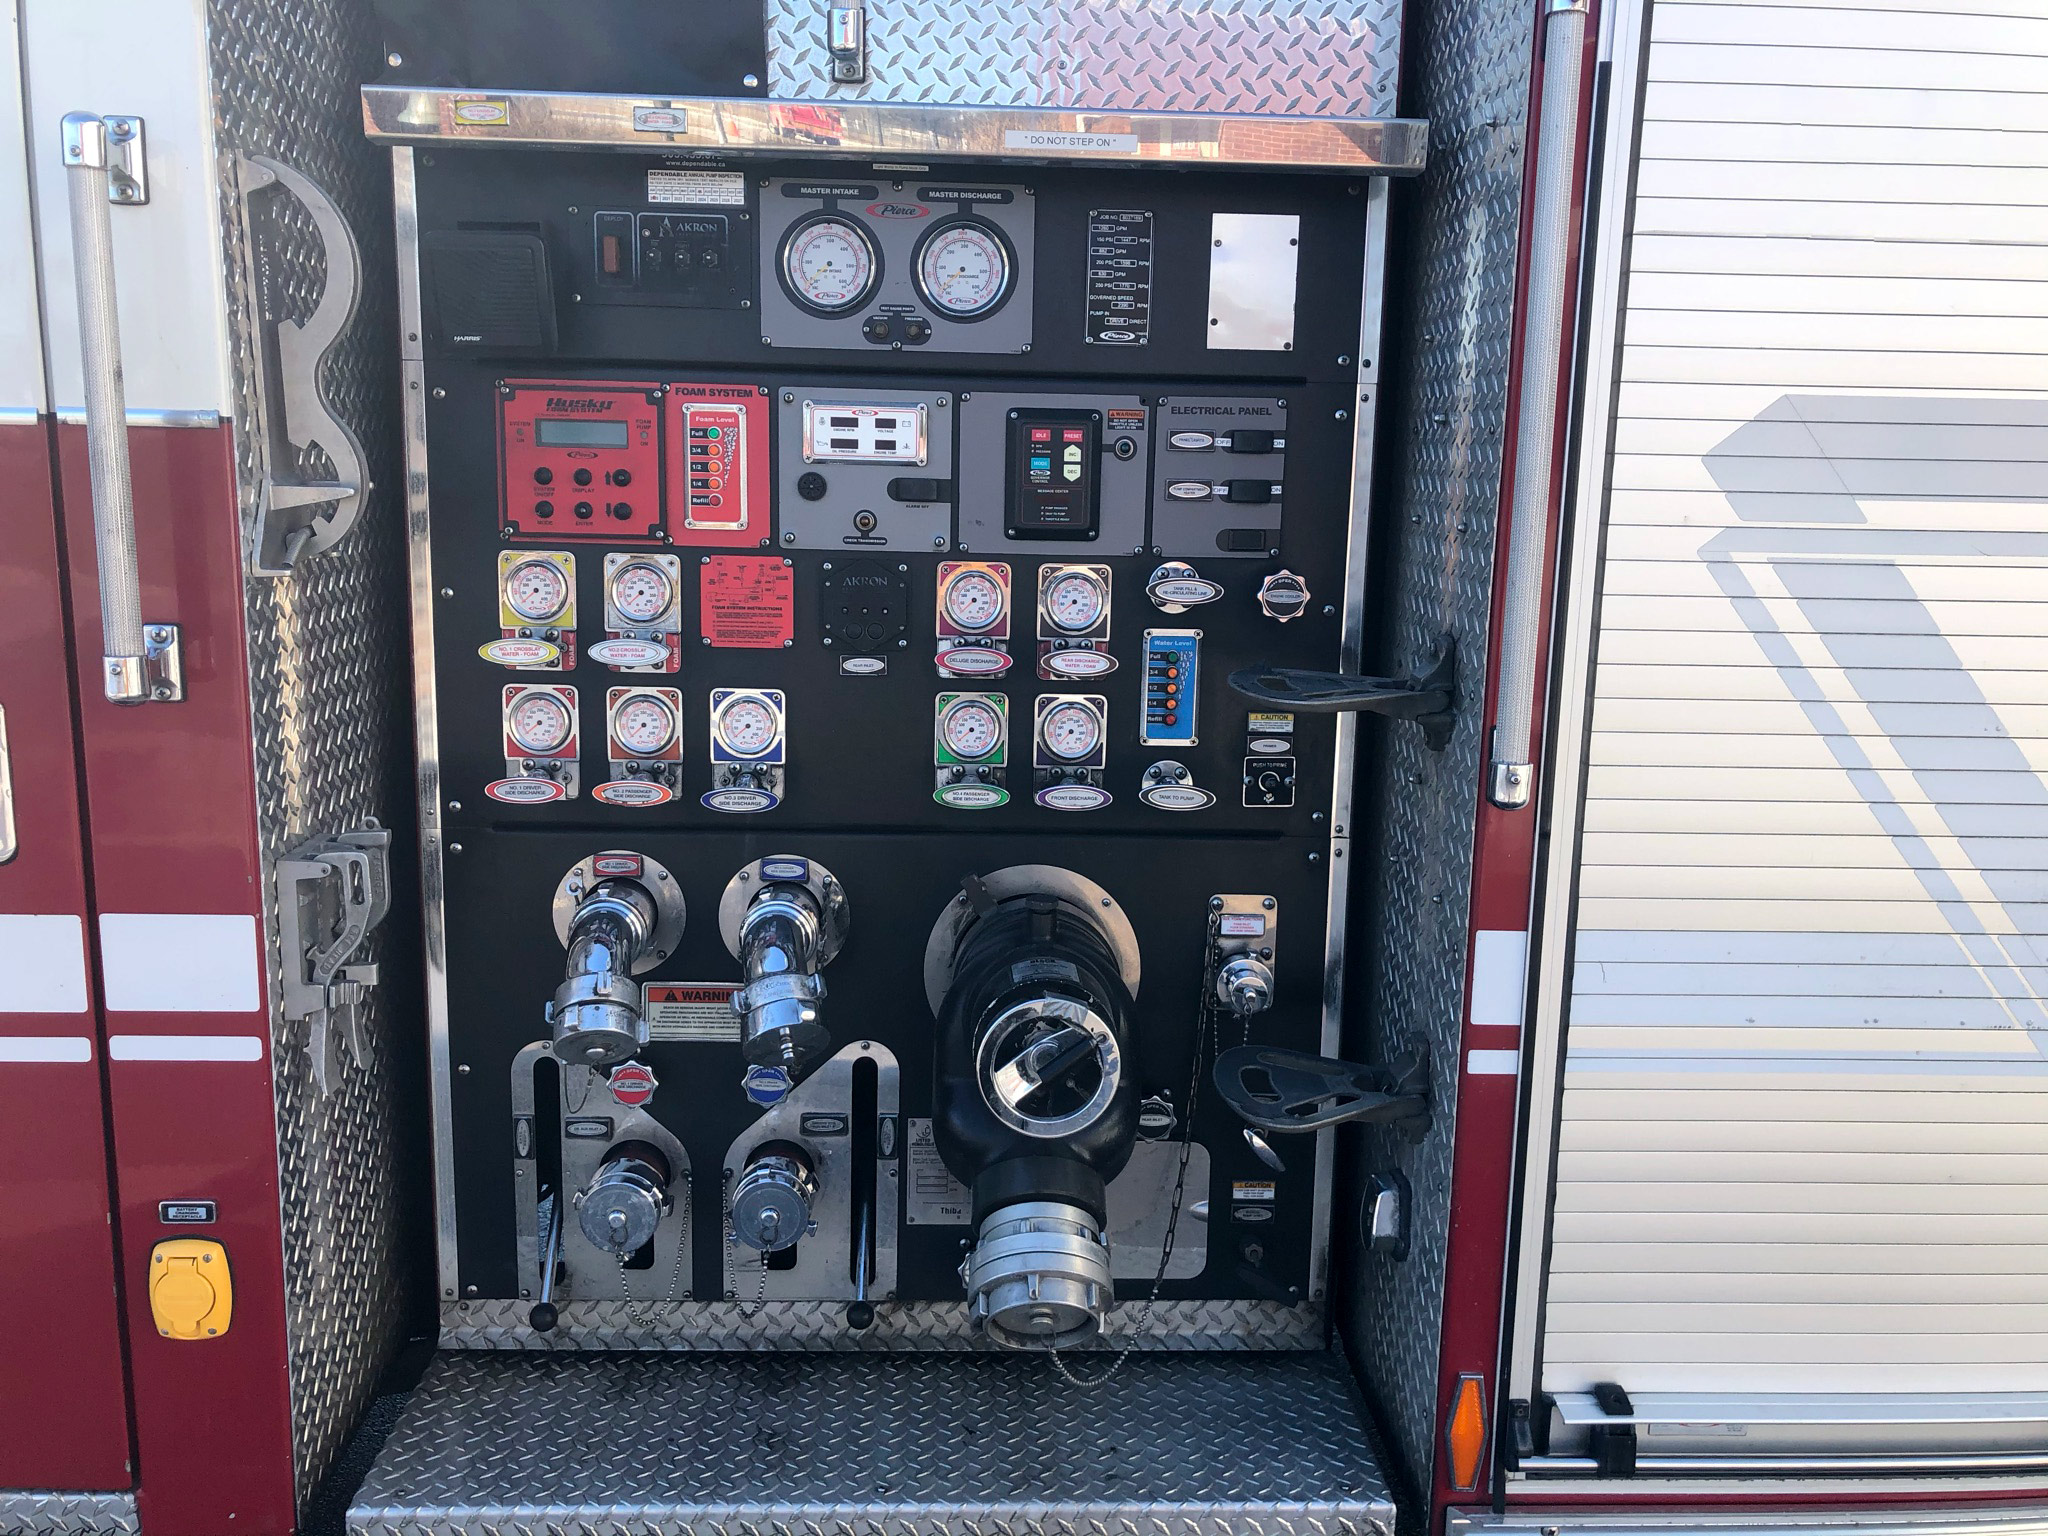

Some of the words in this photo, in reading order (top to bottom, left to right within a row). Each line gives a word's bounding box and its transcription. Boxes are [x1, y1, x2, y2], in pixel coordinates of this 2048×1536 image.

[1031, 136, 1044, 144] DO
[1047, 136, 1066, 144] NOT
[1070, 138, 1094, 146] STEP
[881, 204, 916, 215] Pierce
[676, 223, 717, 232] AKRON
[675, 387, 706, 396] FOAM
[709, 388, 753, 397] SYSTEM
[547, 398, 613, 411] Husky
[1171, 406, 1235, 415] ELECTRICAL
[843, 577, 888, 586] AKRON
